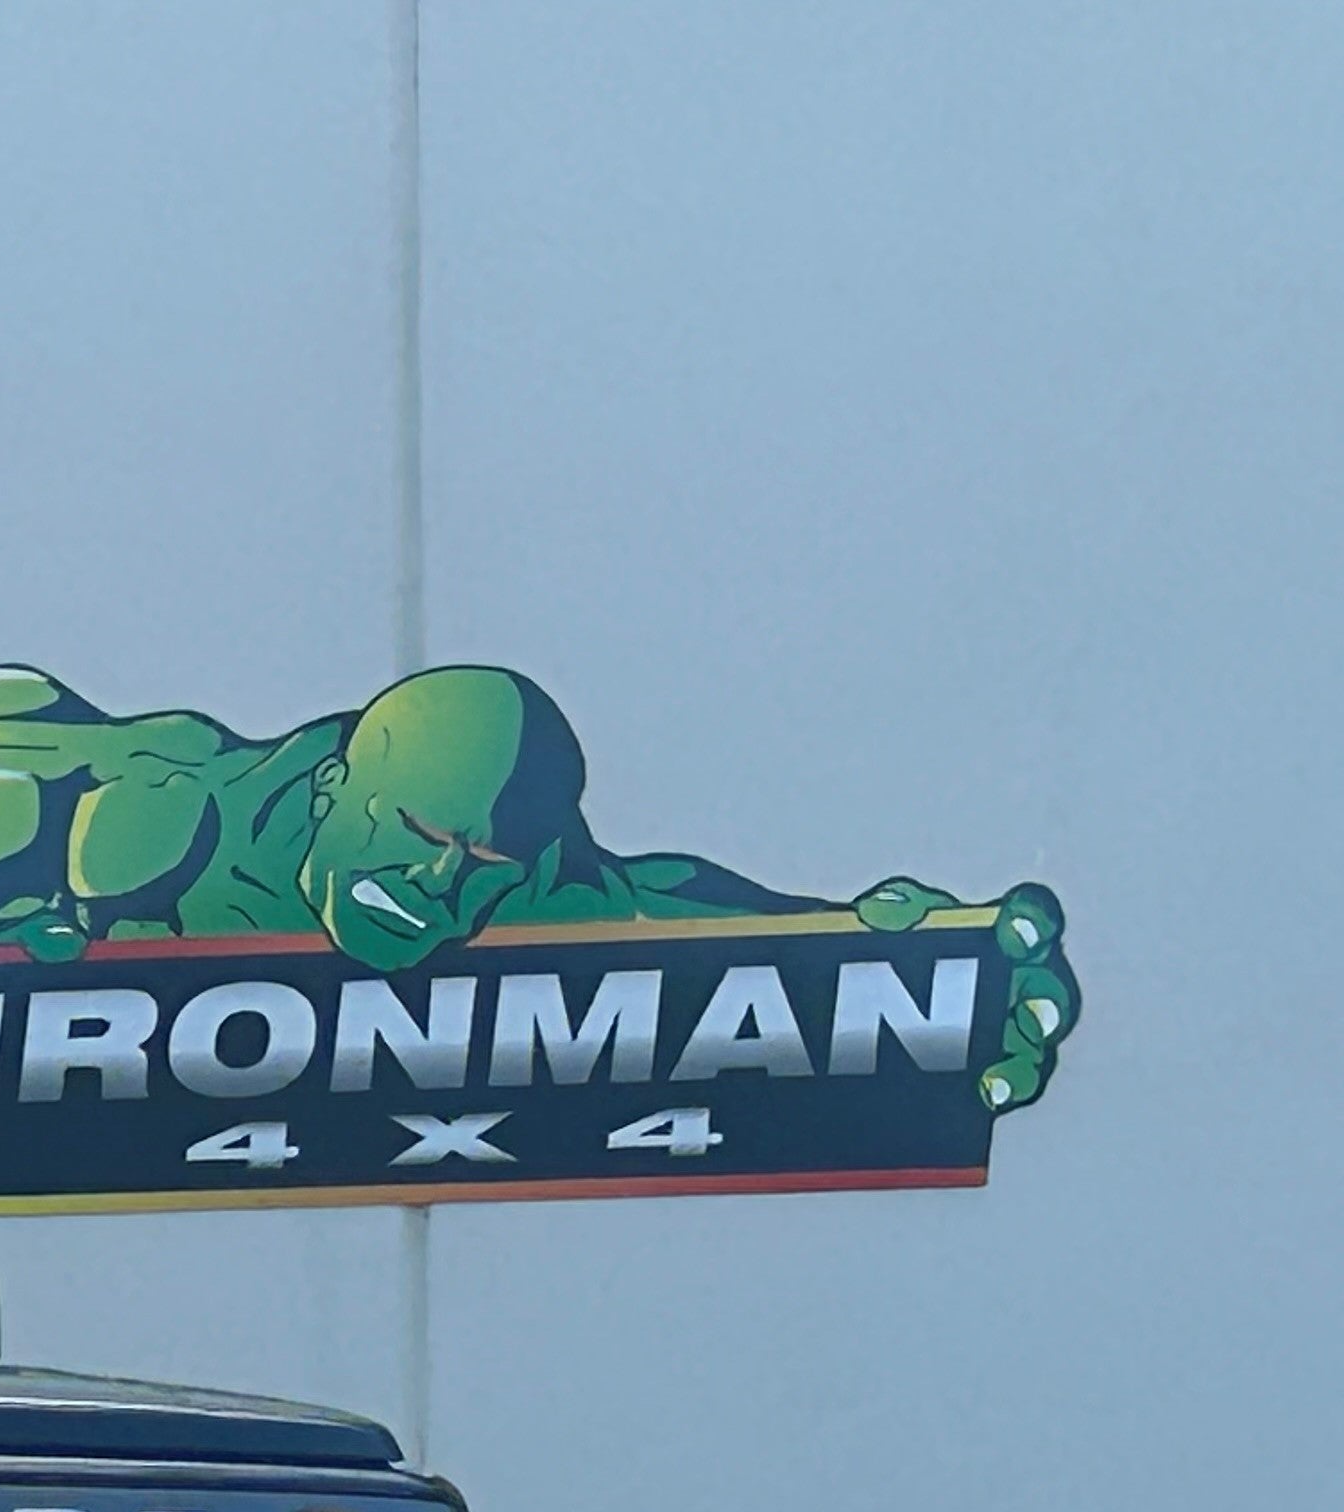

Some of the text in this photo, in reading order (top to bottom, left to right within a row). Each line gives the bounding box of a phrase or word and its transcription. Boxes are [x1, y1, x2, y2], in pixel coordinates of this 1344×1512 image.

[184, 1109, 724, 1169] 4 X 4
